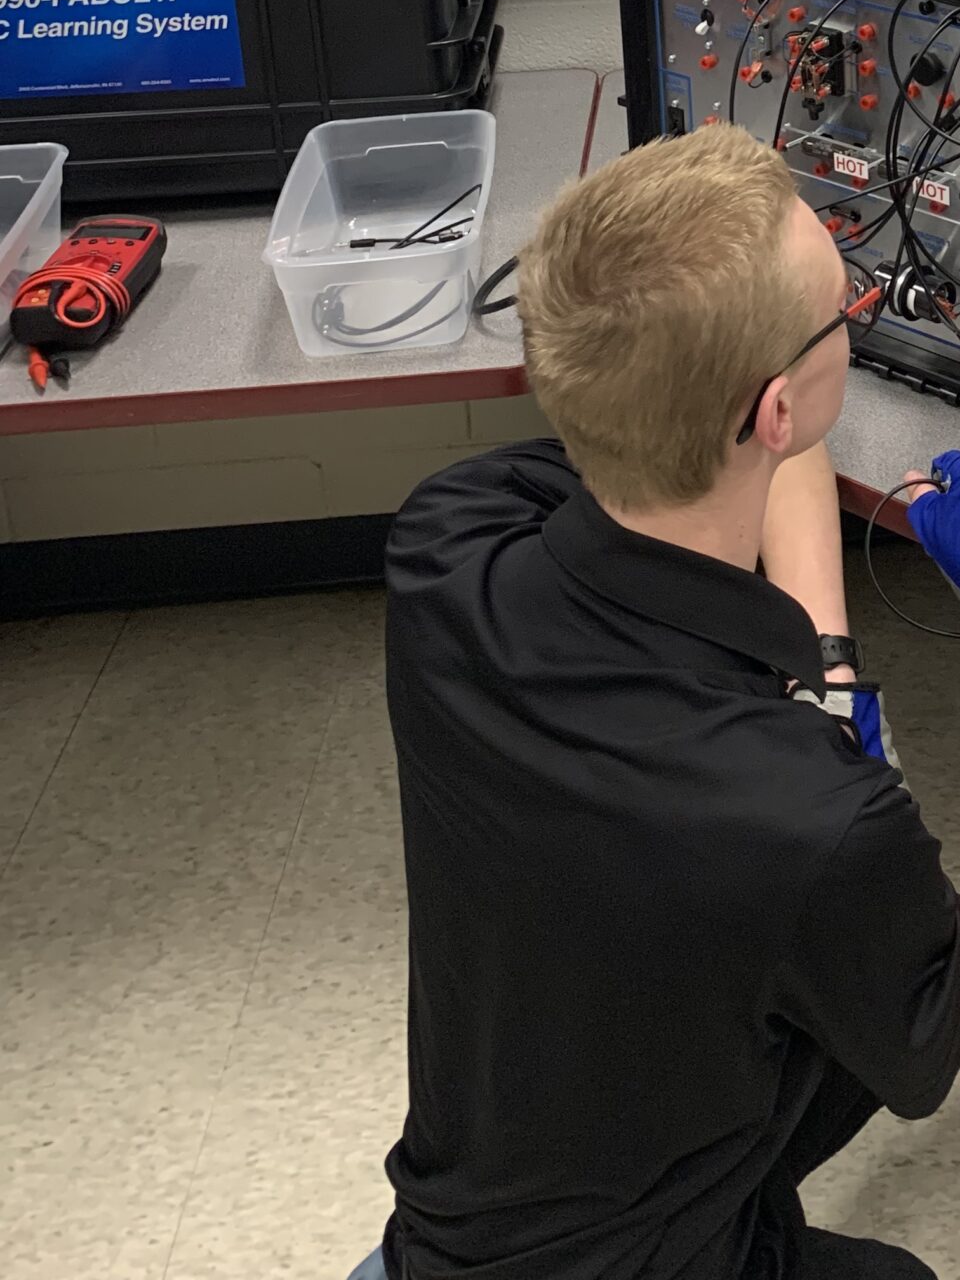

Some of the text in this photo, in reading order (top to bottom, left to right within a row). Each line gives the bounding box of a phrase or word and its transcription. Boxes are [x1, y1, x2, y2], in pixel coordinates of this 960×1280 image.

[17, 16, 128, 39] Learning
[135, 13, 228, 38] System
[836, 157, 865, 180] HOT
